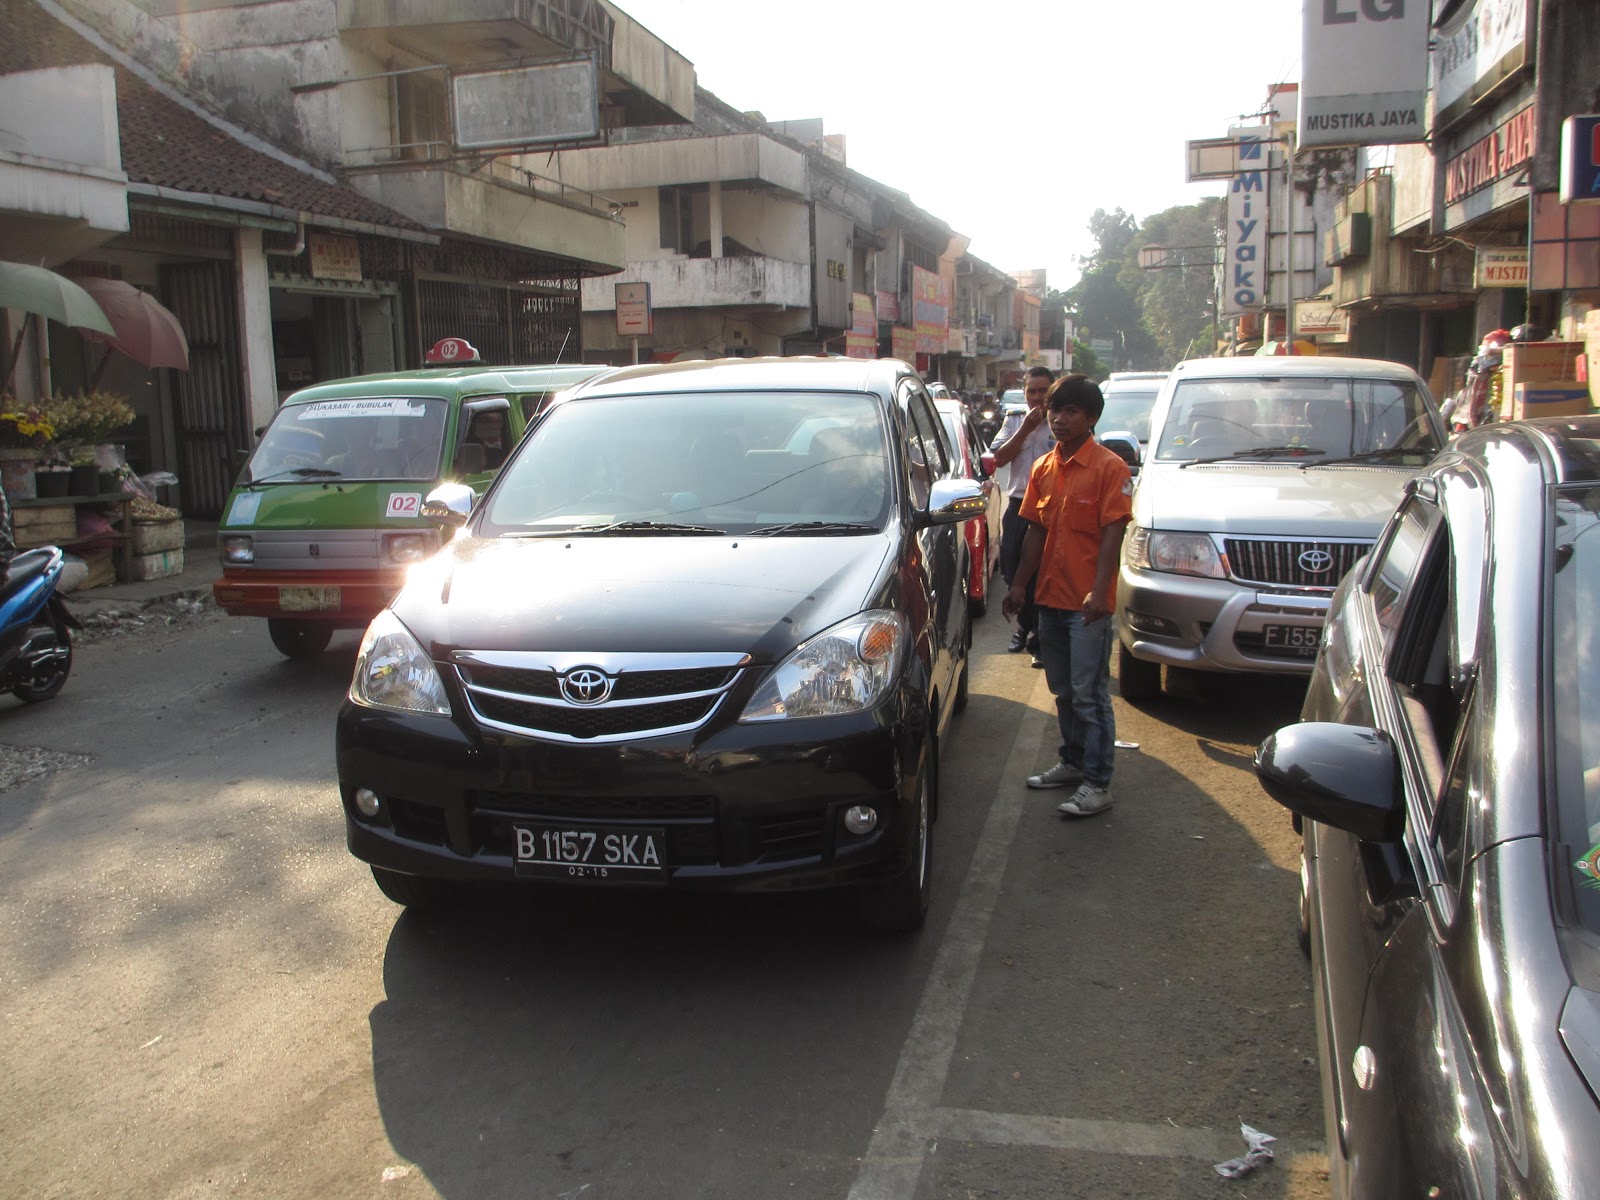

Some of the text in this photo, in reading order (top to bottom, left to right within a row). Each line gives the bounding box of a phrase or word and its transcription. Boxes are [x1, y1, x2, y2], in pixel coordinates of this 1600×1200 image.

[1307, 109, 1417, 131] MUSTIKA JAYA
[1444, 105, 1535, 204] MUSTIKA JAYA
[1232, 169, 1263, 306] Miyako
[443, 343, 456, 355] 02
[356, 401, 393, 409] BUBULAK
[392, 496, 417, 511] 02
[1265, 626, 1321, 647] F 155
[517, 828, 660, 865] B 1157 SKA
